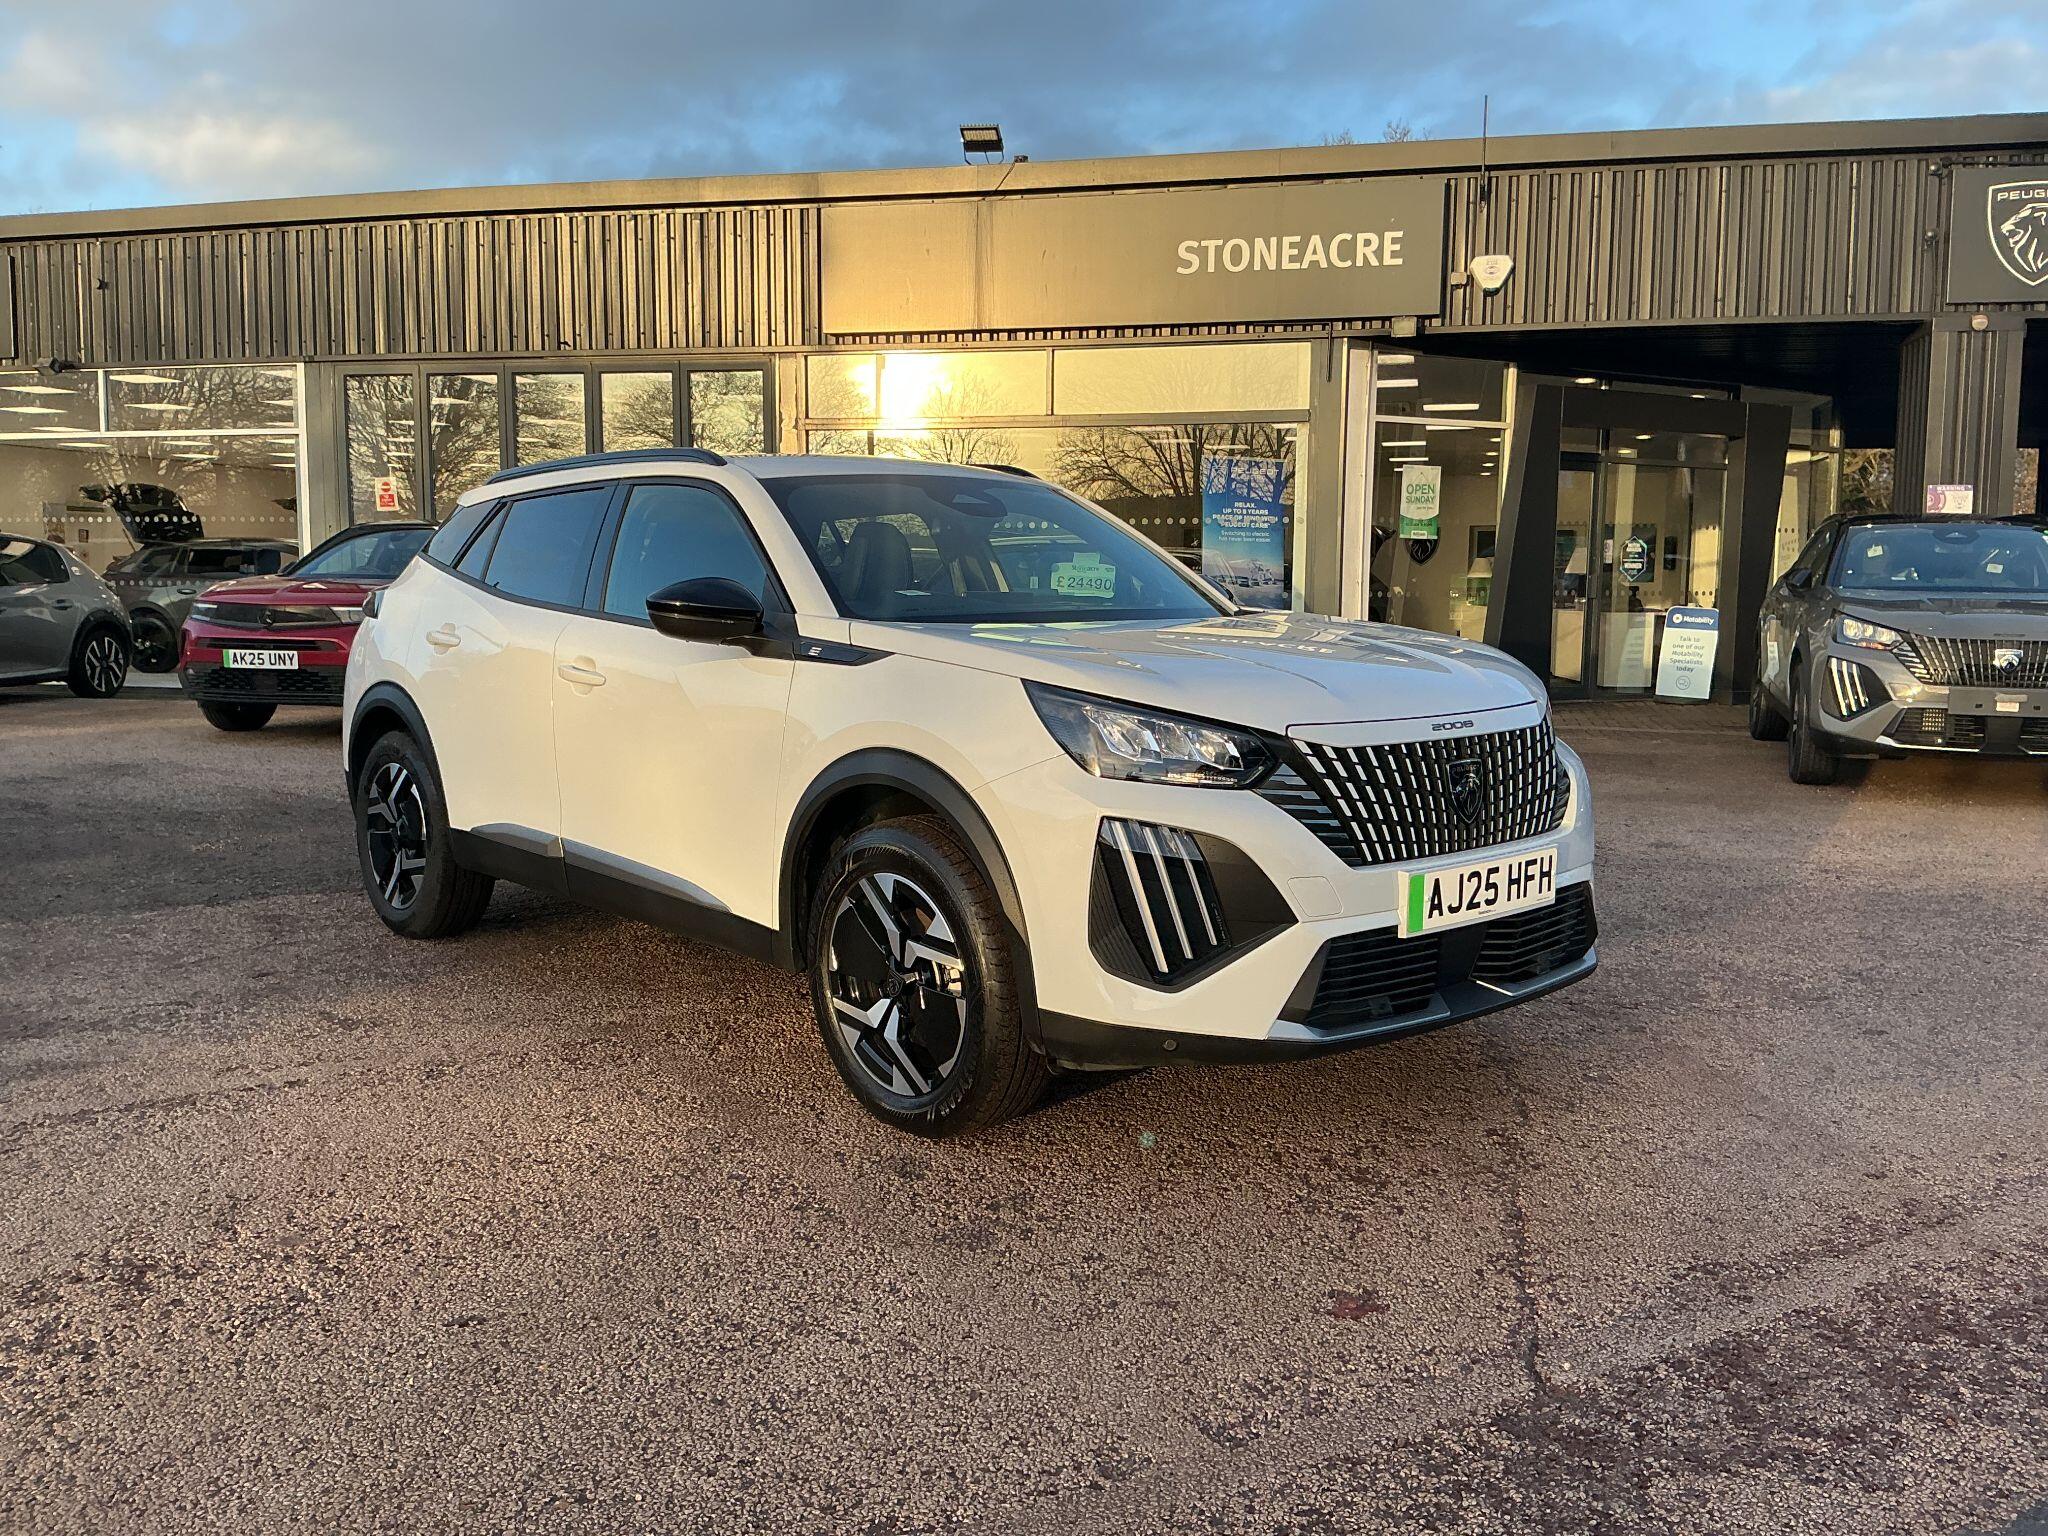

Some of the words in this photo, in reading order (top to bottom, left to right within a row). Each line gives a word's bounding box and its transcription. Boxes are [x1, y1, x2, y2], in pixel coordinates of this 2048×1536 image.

[1998, 189, 2048, 202] PEUG
[1176, 230, 1404, 275] STONEACRE
[1231, 467, 1280, 475] PEUGEOT
[1406, 483, 1435, 495] OPEN
[1405, 495, 1435, 504] SUNDAY
[1683, 615, 1715, 625] Motability
[232, 652, 265, 666] AK25
[268, 652, 295, 666] UNY
[1671, 650, 1704, 658] Motability
[1669, 657, 1703, 665] Specialists
[1431, 720, 1475, 731] 2008
[1427, 865, 1500, 919] AJ25
[1506, 854, 1553, 901] HFH
